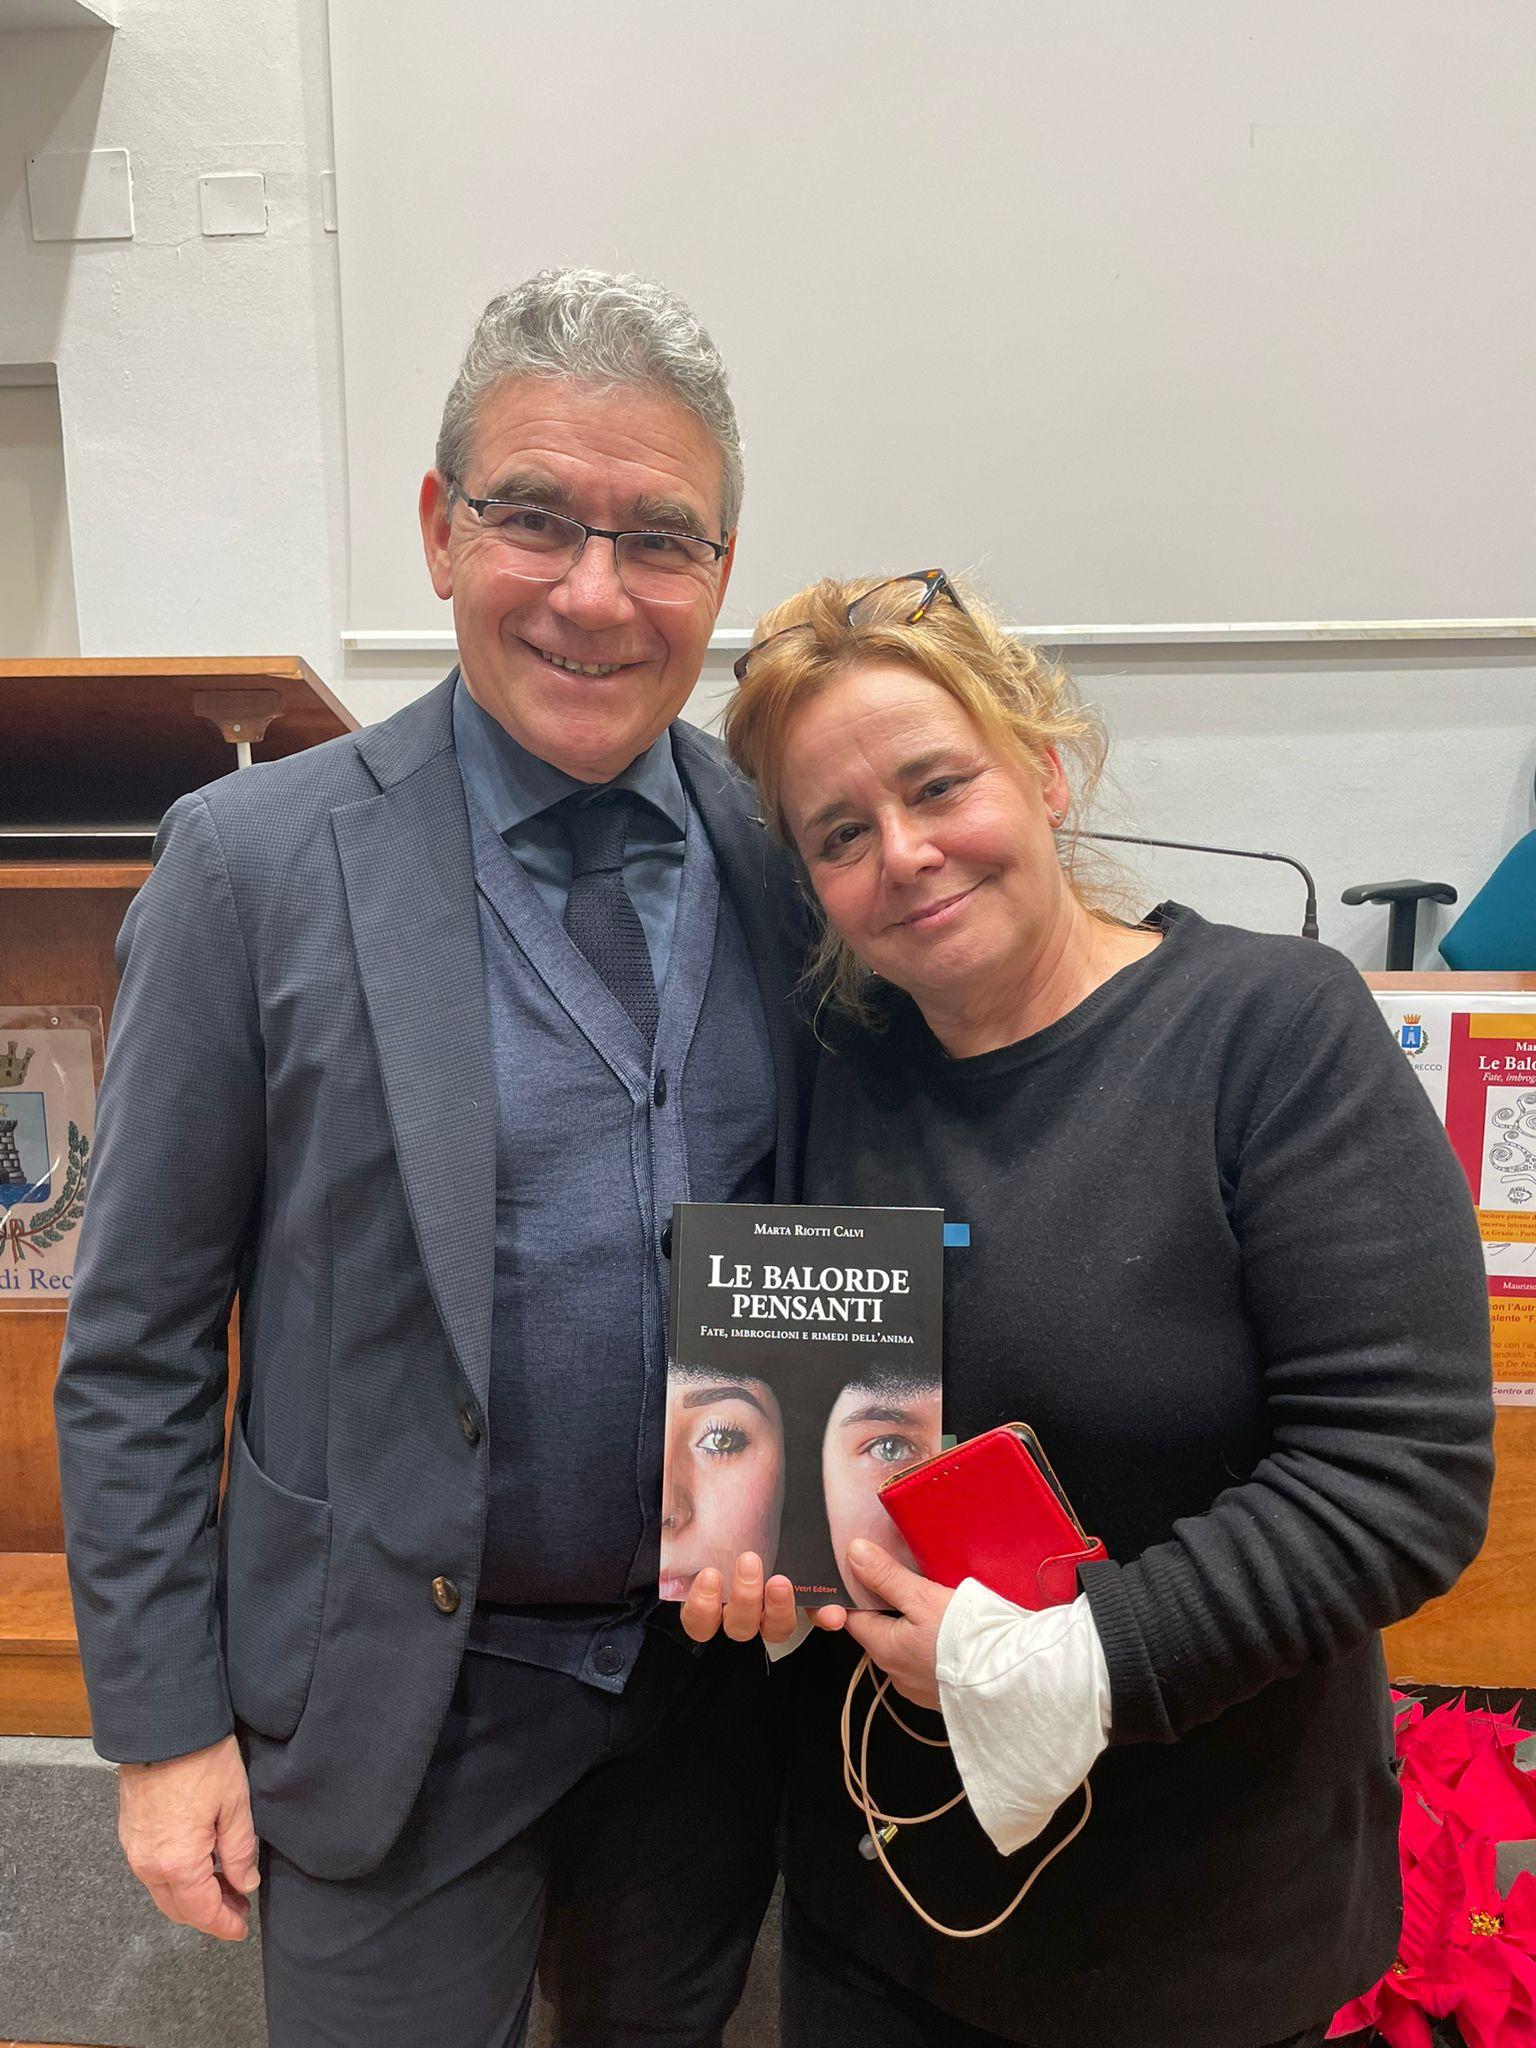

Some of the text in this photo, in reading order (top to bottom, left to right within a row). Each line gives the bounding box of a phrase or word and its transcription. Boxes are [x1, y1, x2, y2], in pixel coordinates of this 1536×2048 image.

[1414, 1063, 1443, 1072] RECCO
[1478, 1055, 1500, 1070] Le
[1482, 1072, 1503, 1083] Fate,
[0, 1268, 73, 1289] di Rec
[707, 1254, 910, 1294] LE BALORDE
[731, 1293, 884, 1323] PENSANTI
[731, 1328, 799, 1340] IMBROGLIONI
[811, 1331, 849, 1342] RIMEDI
[1525, 1387, 1534, 1395] di
[812, 1585, 838, 1594] Editore
